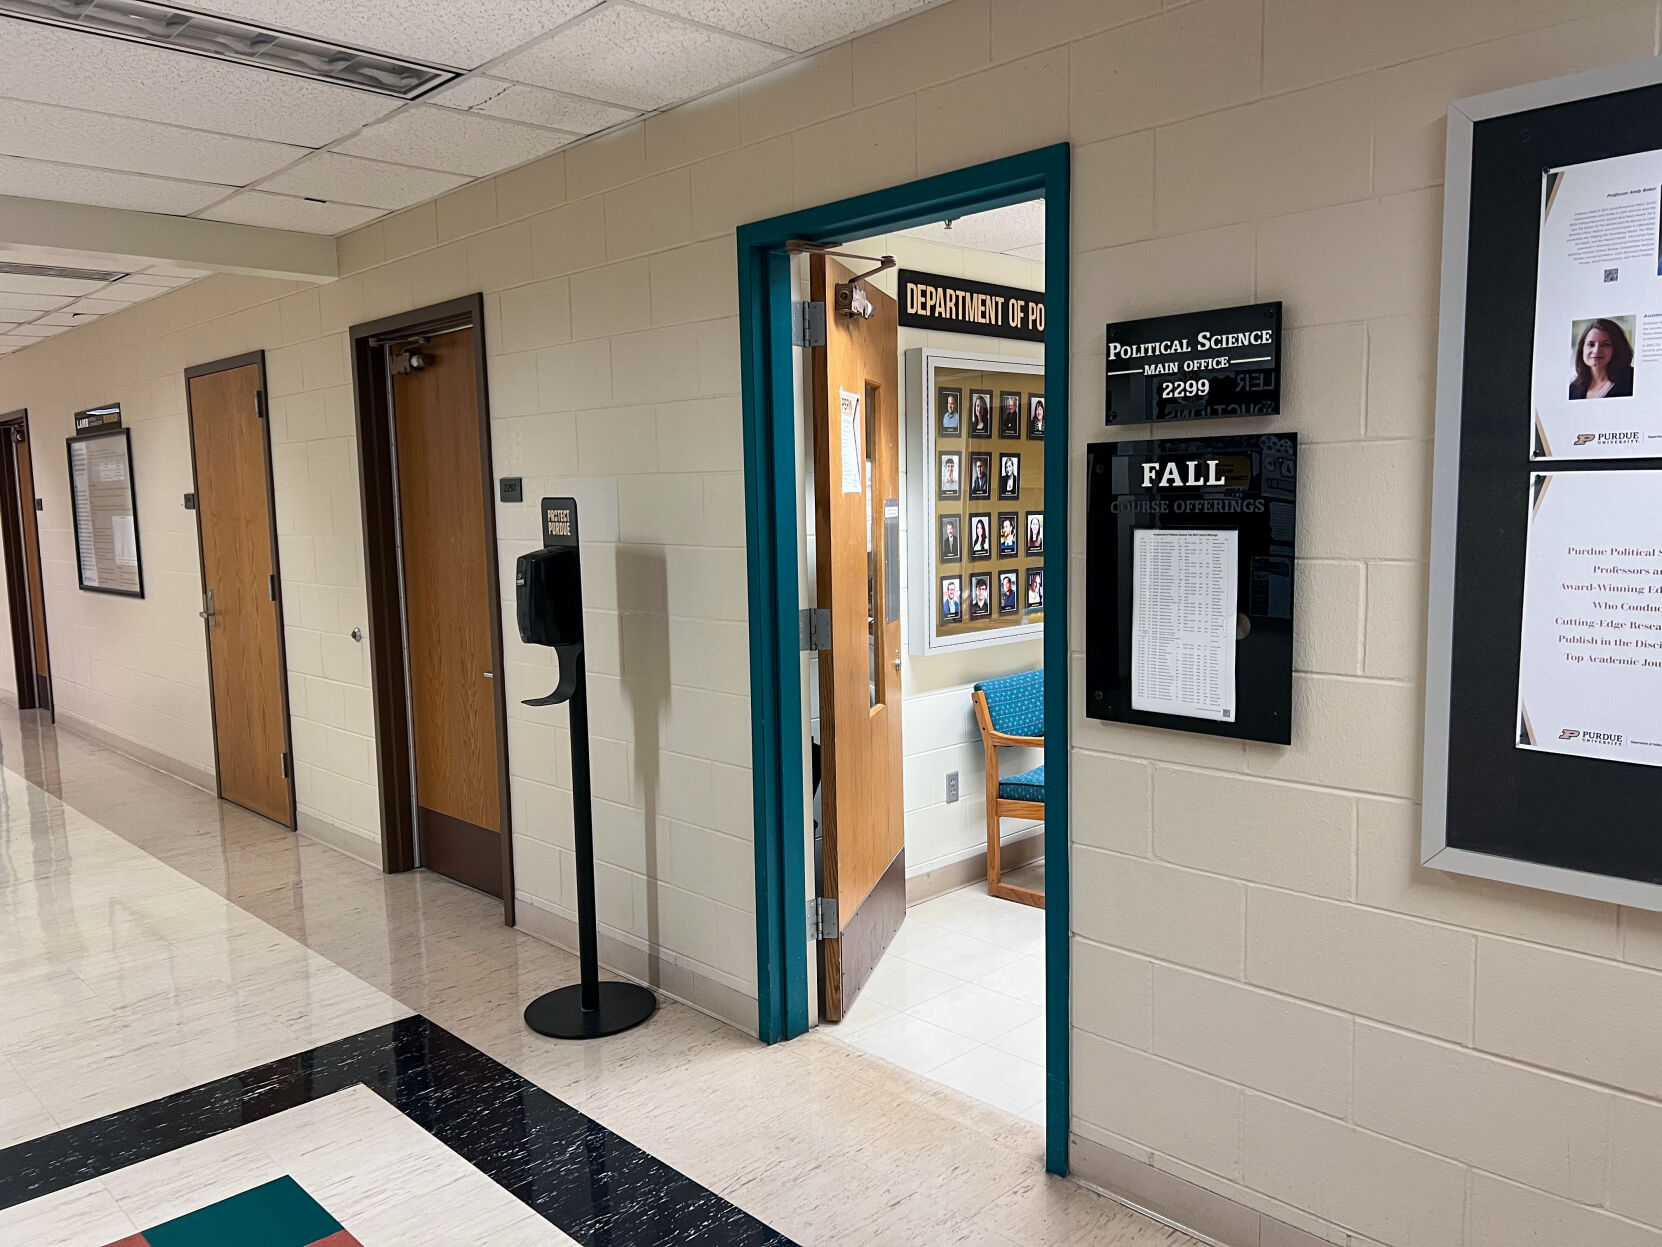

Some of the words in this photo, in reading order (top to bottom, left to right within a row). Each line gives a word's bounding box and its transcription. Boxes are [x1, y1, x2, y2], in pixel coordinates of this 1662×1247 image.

[906, 282, 1004, 326] DEPARTMENT
[1009, 298, 1025, 328] OF
[1028, 302, 1045, 332] PO
[1144, 362, 1179, 376] MAIN
[1183, 357, 1229, 372] OFFICE
[1162, 379, 1210, 398] 2299
[1598, 431, 1639, 441] PURDUE
[1141, 460, 1225, 487] FALL
[1110, 500, 1169, 514] COURSE
[1173, 499, 1265, 514] OFFERINGS
[547, 510, 570, 521] PROTECT
[548, 523, 571, 535] PURDUE
[1568, 547, 1607, 556] Purdue
[1610, 548, 1656, 557] Political
[1593, 565, 1650, 575] Professors
[1562, 583, 1645, 594] Award-Winning
[1593, 601, 1618, 610] Who
[1555, 617, 1627, 629] Cutting-Edge
[1559, 635, 1598, 645] Publish
[1600, 637, 1611, 646] in
[1614, 639, 1632, 647] the
[1565, 653, 1584, 664] Top
[1588, 654, 1640, 666] Academic
[1582, 731, 1623, 742] PURDUE
